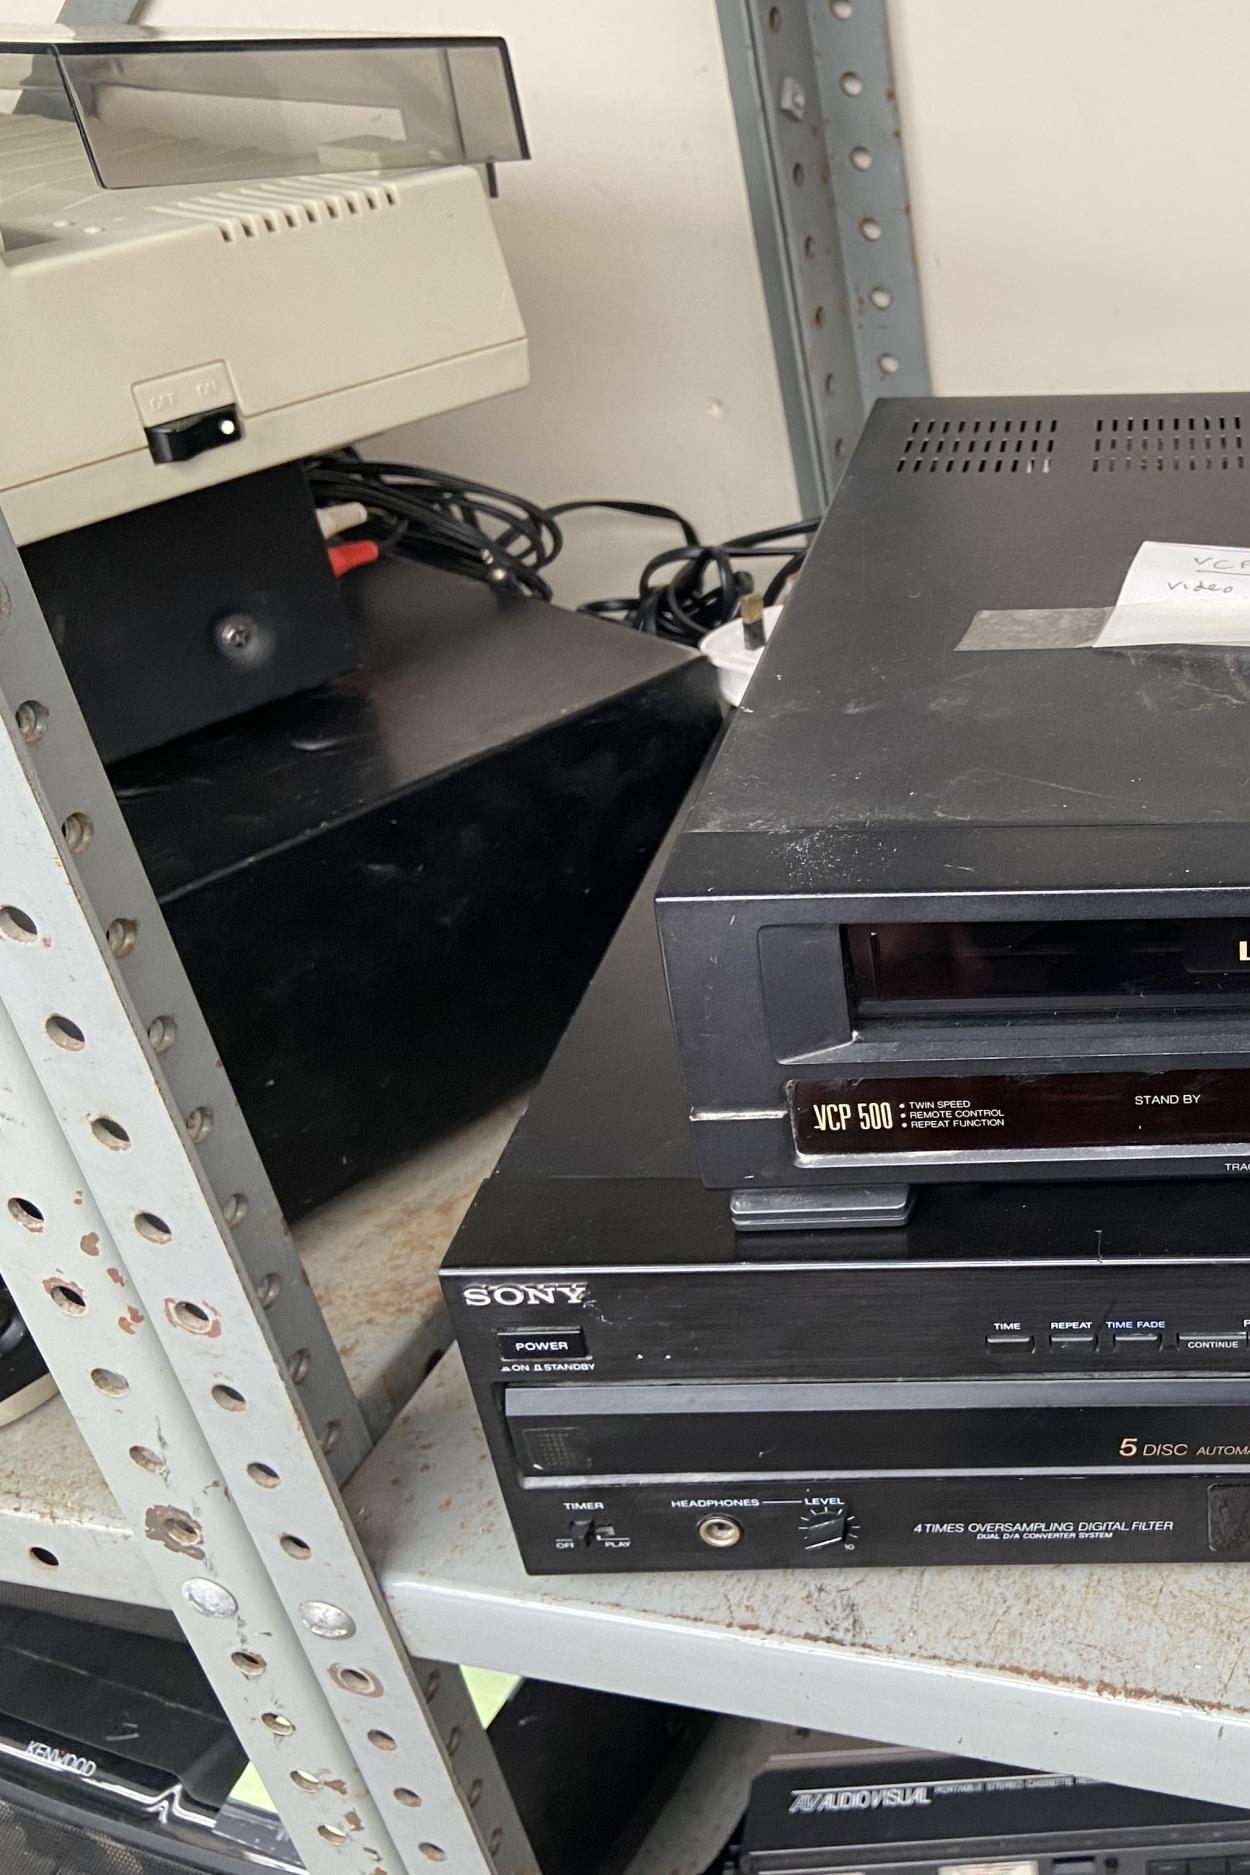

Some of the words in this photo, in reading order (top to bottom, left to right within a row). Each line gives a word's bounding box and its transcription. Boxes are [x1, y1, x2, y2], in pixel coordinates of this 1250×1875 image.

[909, 1101, 935, 1109] TWIN
[937, 1100, 971, 1108] SPEED
[1134, 1095, 1179, 1105] STAND
[1182, 1094, 1201, 1104] BY
[813, 1104, 852, 1131] VCP
[857, 1102, 893, 1130] 500
[909, 1111, 953, 1119] REMOTE
[955, 1109, 1005, 1118] CONTROL
[911, 1120, 951, 1129] REPEAT
[953, 1119, 1005, 1128] FUNCTION
[463, 1286, 586, 1306] SONY
[993, 1322, 1021, 1331] TIME
[1050, 1321, 1093, 1329] REPEAT
[1105, 1321, 1133, 1329] TIME
[1136, 1320, 1166, 1328] FADE
[515, 1341, 569, 1351] POWER
[1187, 1341, 1239, 1349] CONTINUE
[511, 1364, 530, 1372] ON
[543, 1363, 596, 1371] STANDBY
[1119, 1438, 1138, 1457] 5
[1143, 1444, 1188, 1456] DISC
[563, 1502, 605, 1510] TIMER
[671, 1499, 760, 1508] HEADPHONES
[913, 1524, 922, 1532] 4
[924, 1523, 964, 1532] TIMES
[968, 1522, 1074, 1532] OVERSAMPLING
[1078, 1521, 1129, 1532] DIGITAL
[1131, 1521, 1174, 1531] FILTER
[27, 1741, 97, 1777] KENWOOD
